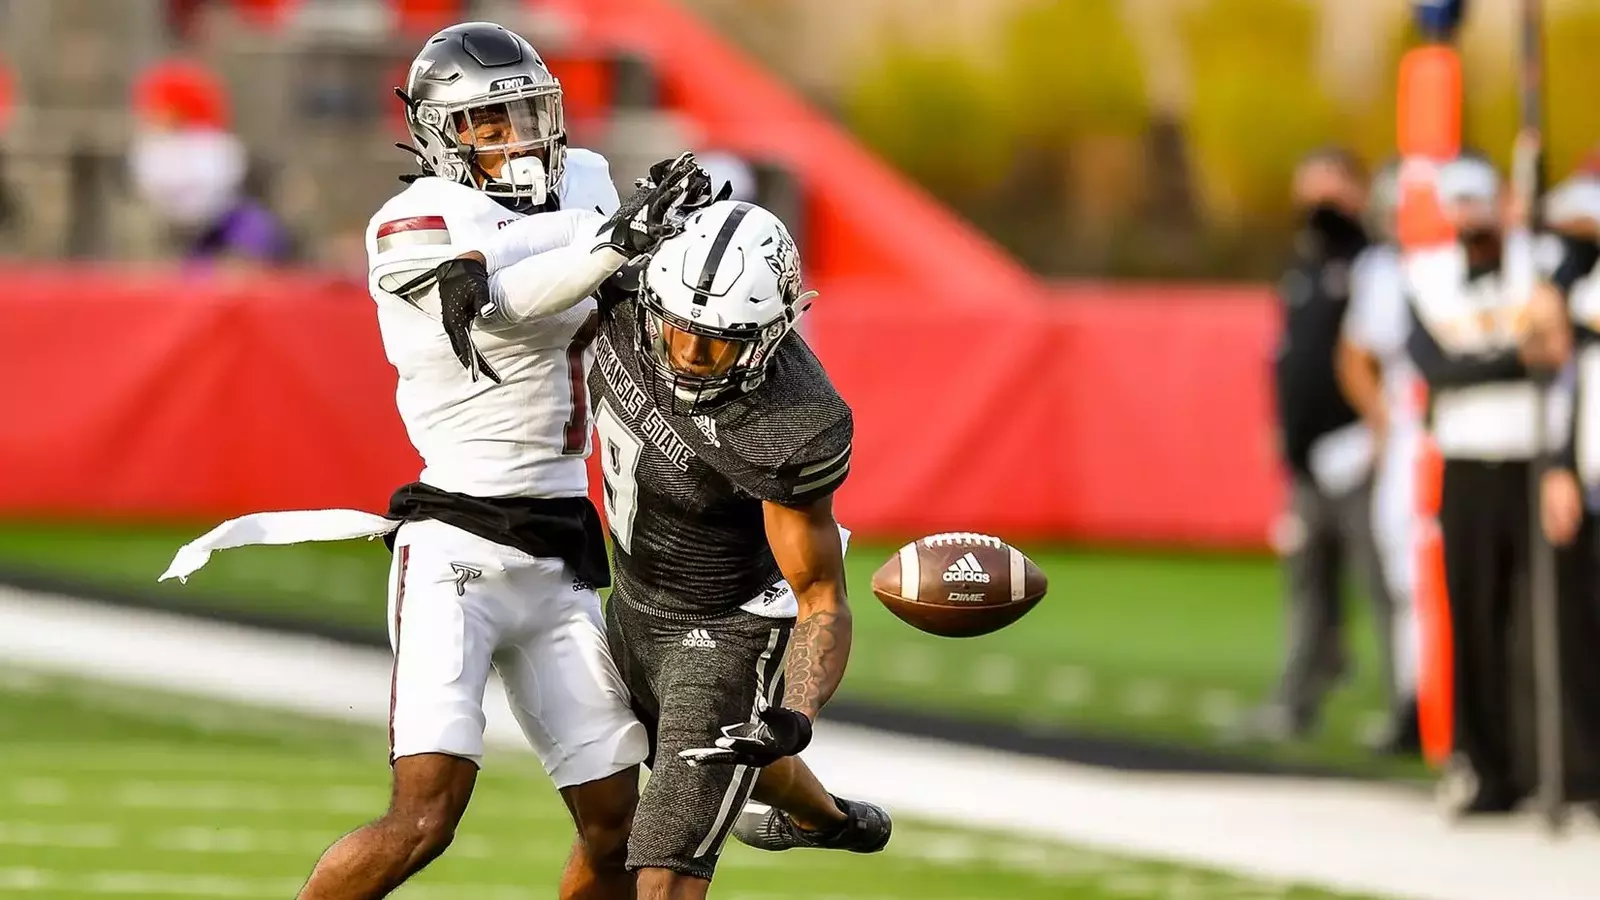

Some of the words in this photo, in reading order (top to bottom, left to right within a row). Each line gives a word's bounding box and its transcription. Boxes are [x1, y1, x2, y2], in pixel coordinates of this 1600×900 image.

[596, 333, 648, 420] ARKANSAS
[640, 407, 697, 472] STATE
[593, 395, 645, 556] 9
[942, 569, 991, 583] adidas
[947, 592, 986, 602] DIME
[681, 636, 717, 649] adidas
